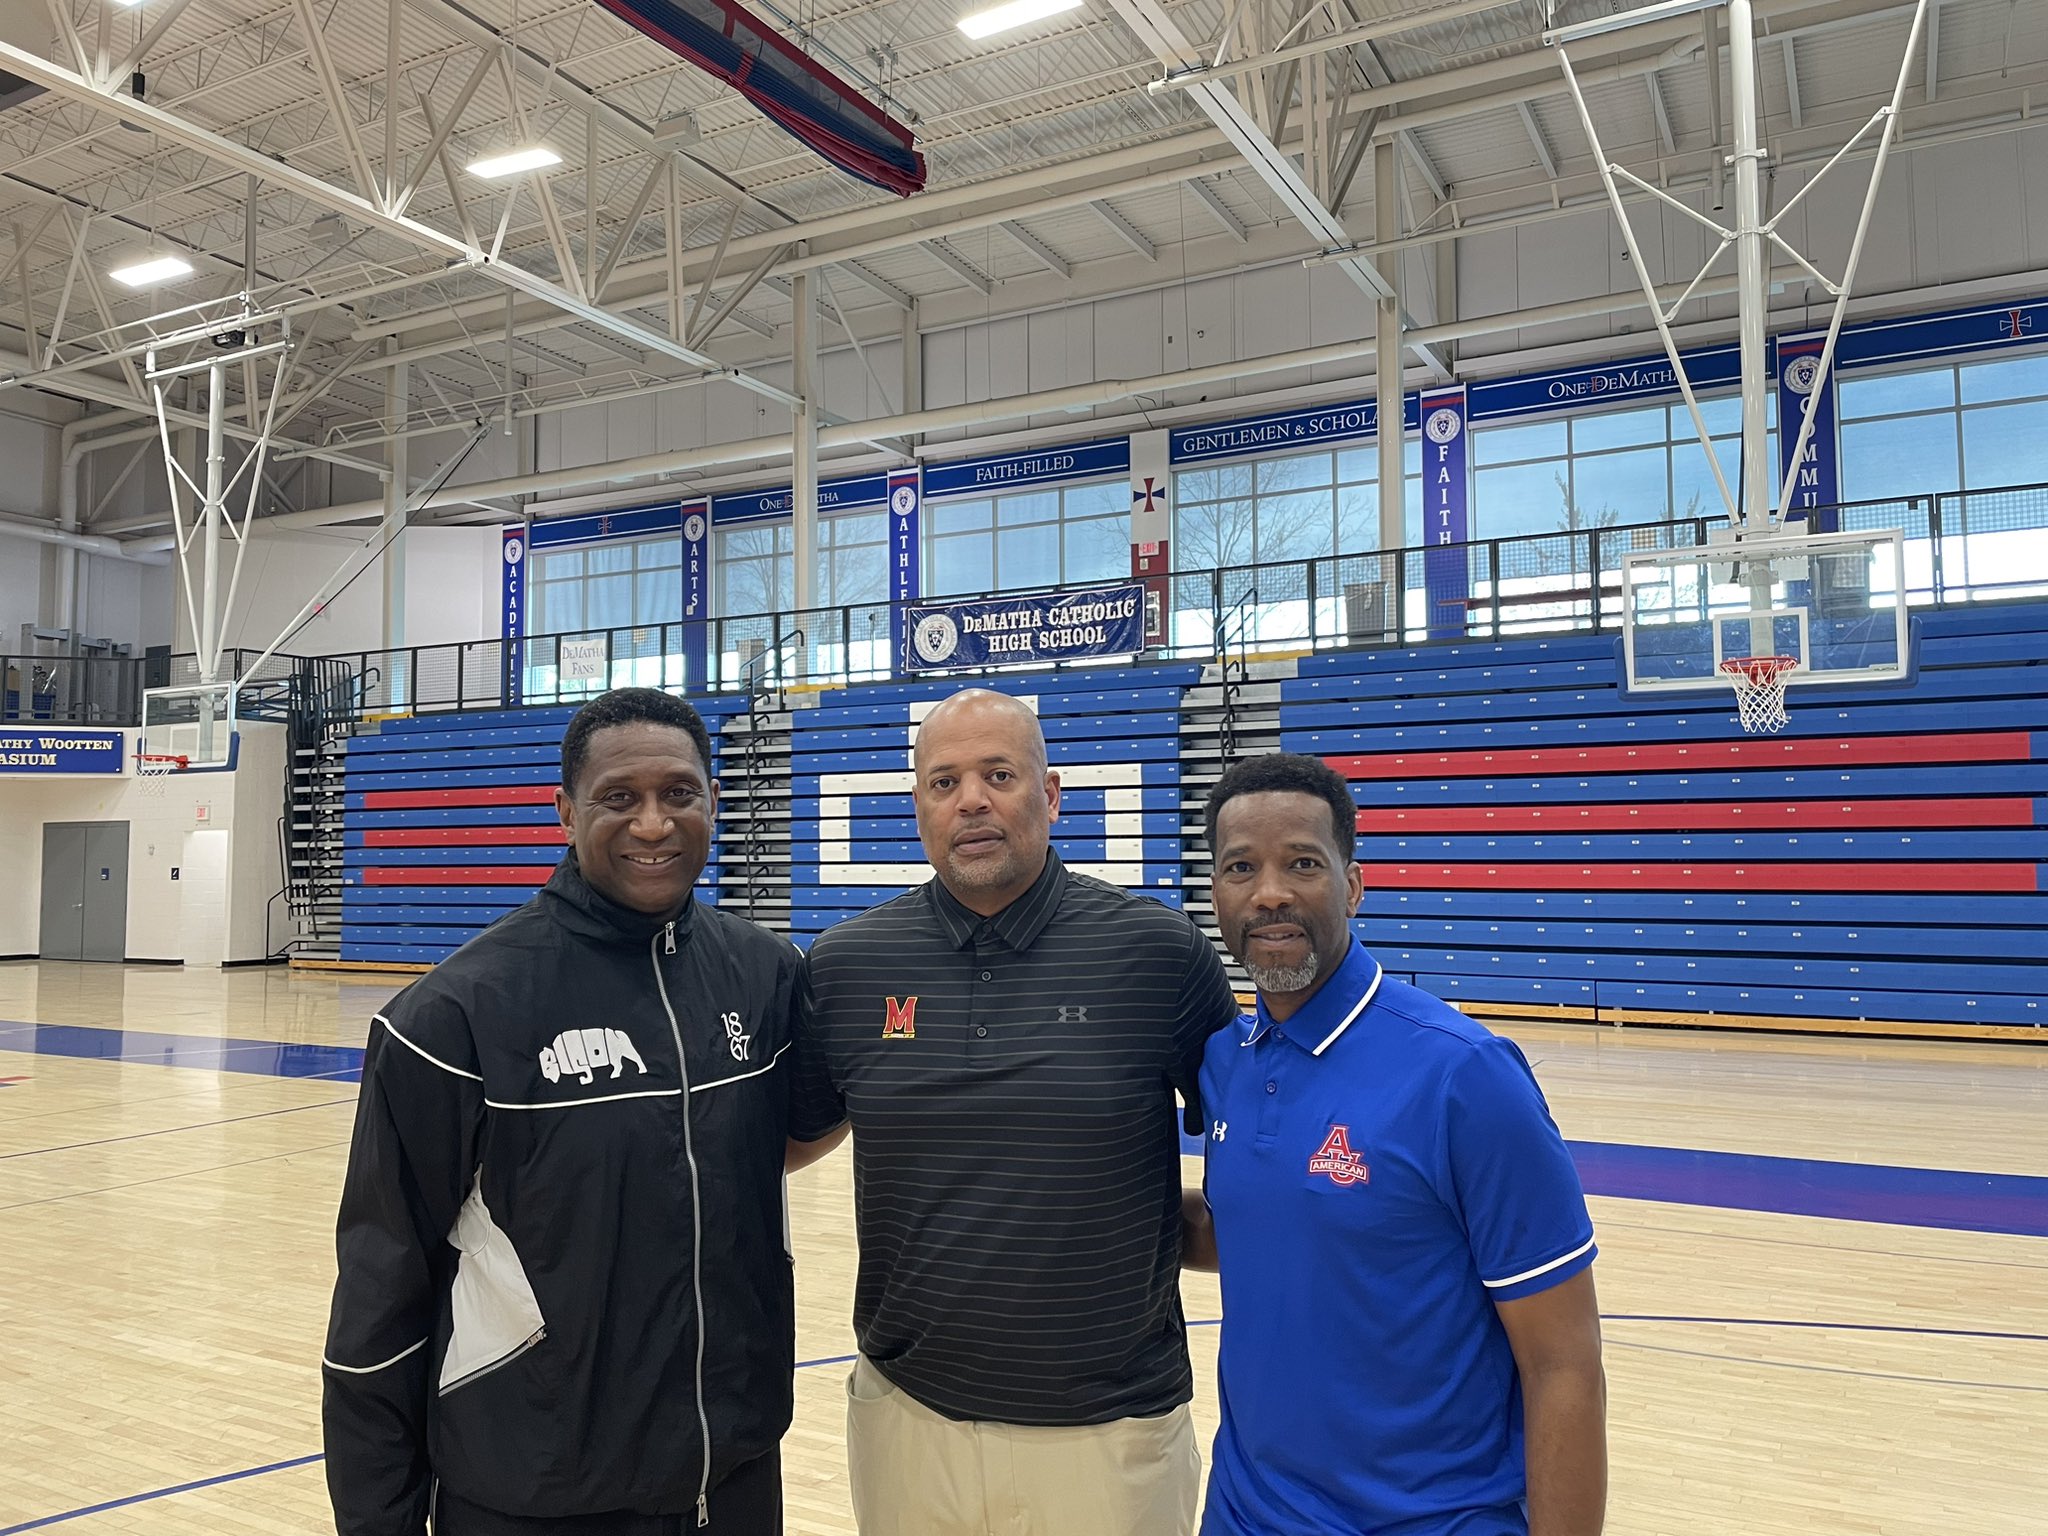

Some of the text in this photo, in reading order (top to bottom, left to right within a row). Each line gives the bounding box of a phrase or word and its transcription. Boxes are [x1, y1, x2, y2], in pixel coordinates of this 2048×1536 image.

[1183, 423, 1290, 453] GENTLEMEN
[1294, 424, 1306, 436] &
[975, 454, 1075, 482] FAITH-FILLED
[1438, 445, 1451, 546] FAITH
[690, 543, 699, 607] ARTS
[1048, 598, 1137, 627] CATHOLIC
[987, 626, 1107, 653] HIGH SCHOOL
[721, 1011, 743, 1039] 18
[883, 996, 919, 1034] M
[1311, 1160, 1366, 1177] AMERICAN
